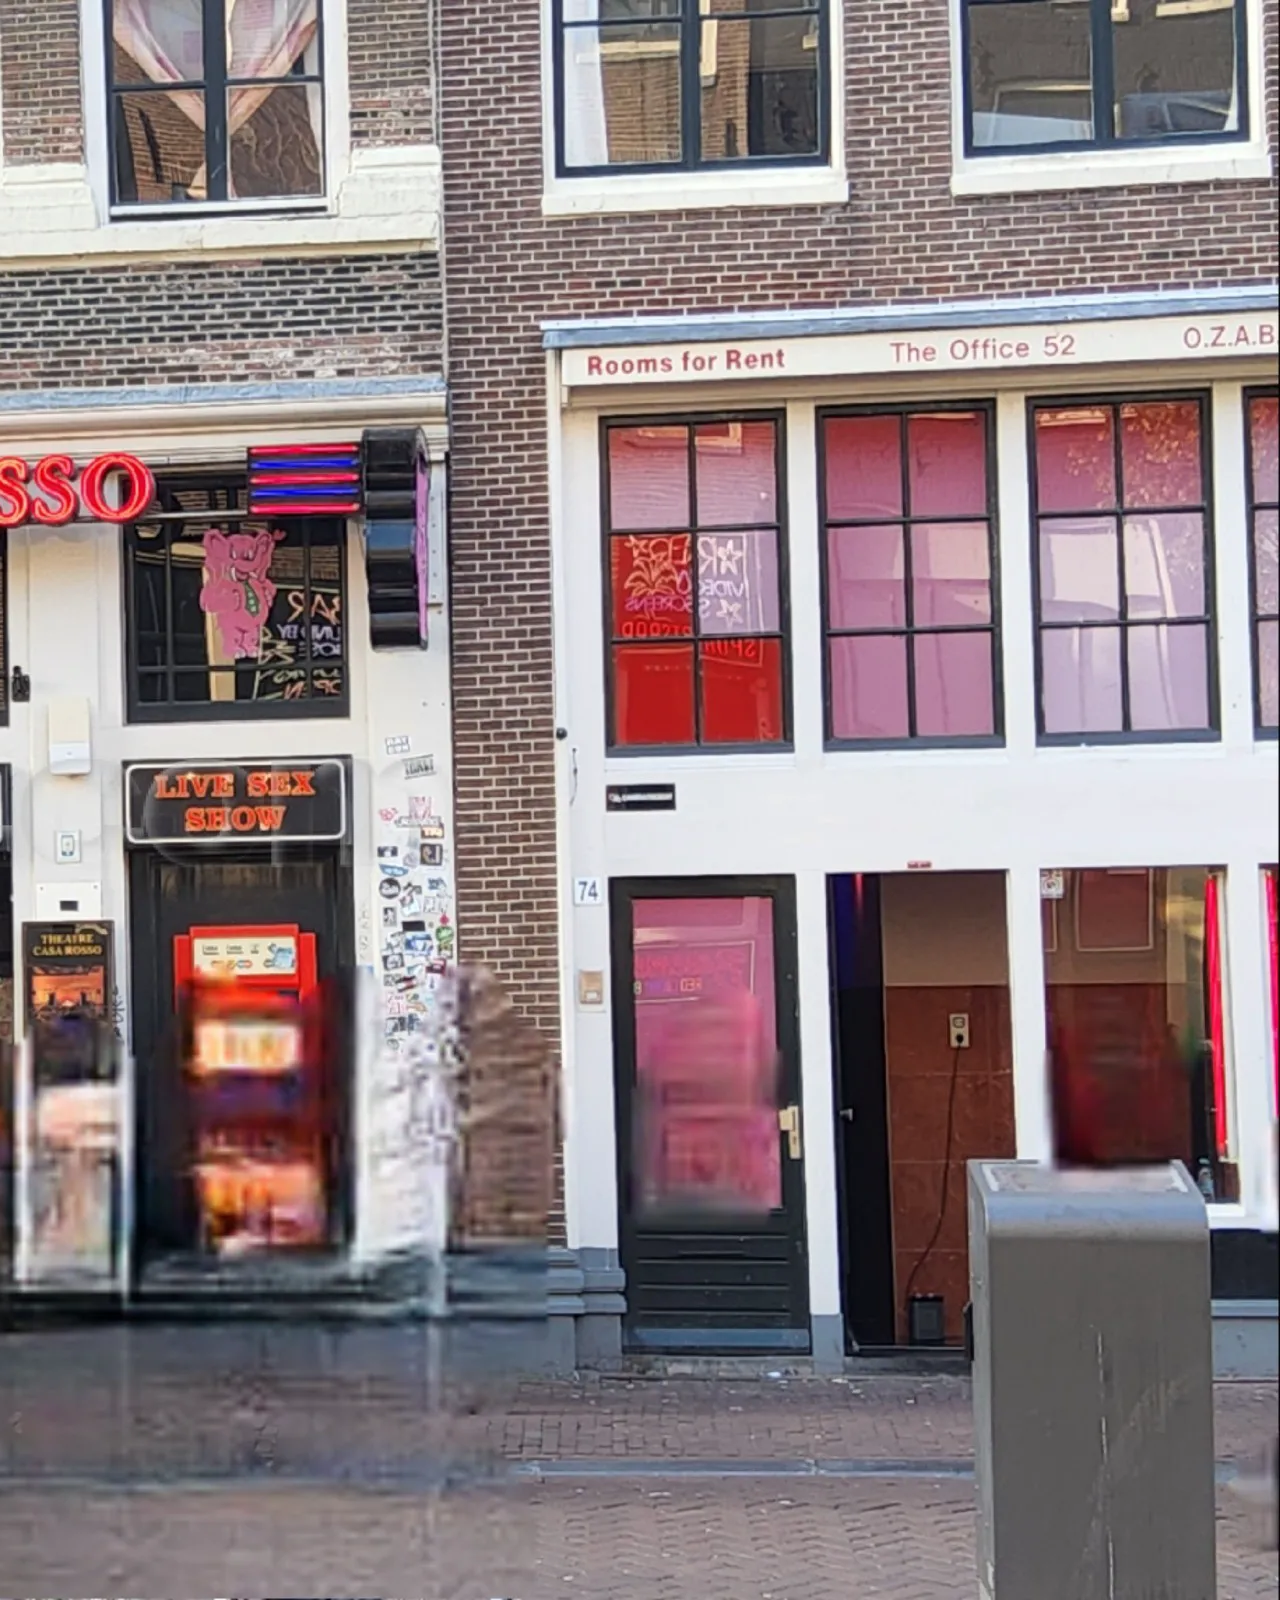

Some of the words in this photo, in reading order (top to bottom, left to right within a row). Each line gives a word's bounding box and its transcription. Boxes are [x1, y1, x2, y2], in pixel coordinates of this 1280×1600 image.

[587, 356, 672, 375] Rooms
[683, 351, 717, 371] for
[726, 349, 785, 370] Rent
[890, 342, 937, 363] The
[949, 338, 1030, 361] Office
[1043, 335, 1076, 357] 52
[154, 772, 234, 799] LIVE
[246, 770, 316, 797] SEX
[184, 805, 287, 832] SHOW
[578, 880, 598, 901] 74
[32, 946, 63, 956] CASA
[64, 945, 102, 955] ROSSO
[40, 933, 94, 944] THEATRE
